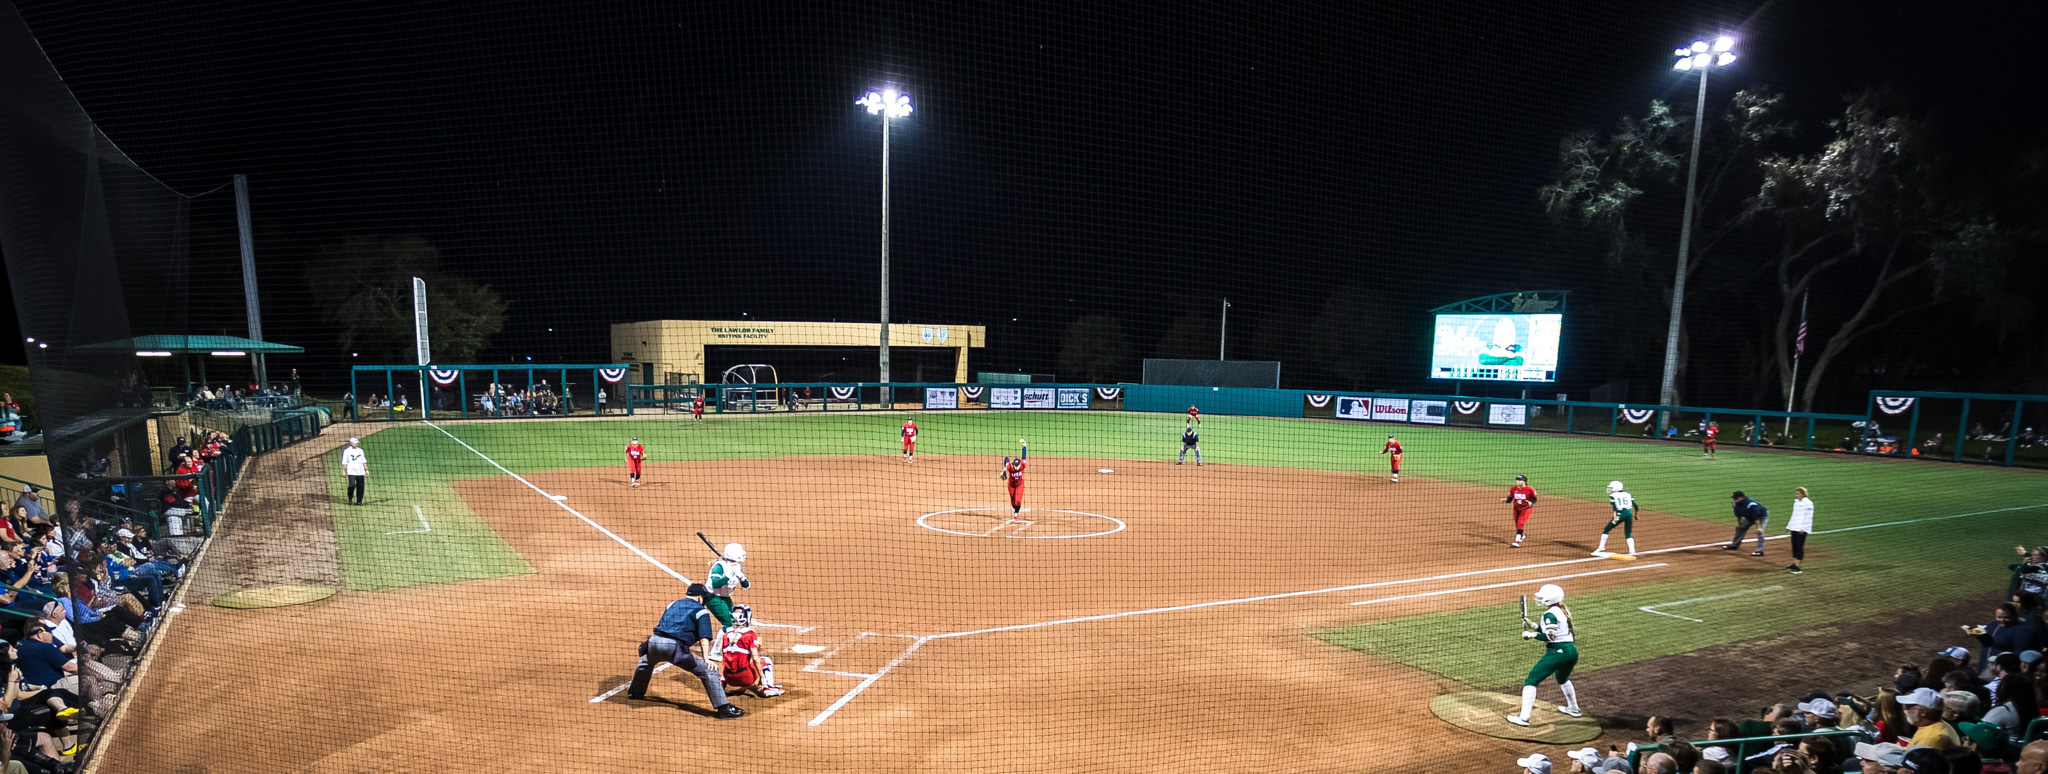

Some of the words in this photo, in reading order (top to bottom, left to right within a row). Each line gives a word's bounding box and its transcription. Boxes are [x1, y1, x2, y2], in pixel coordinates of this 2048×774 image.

[1024, 391, 1049, 401] schutt
[1060, 393, 1088, 403] DICK'S
[1374, 404, 1407, 415] Wilson
[1617, 496, 1630, 507] 16
